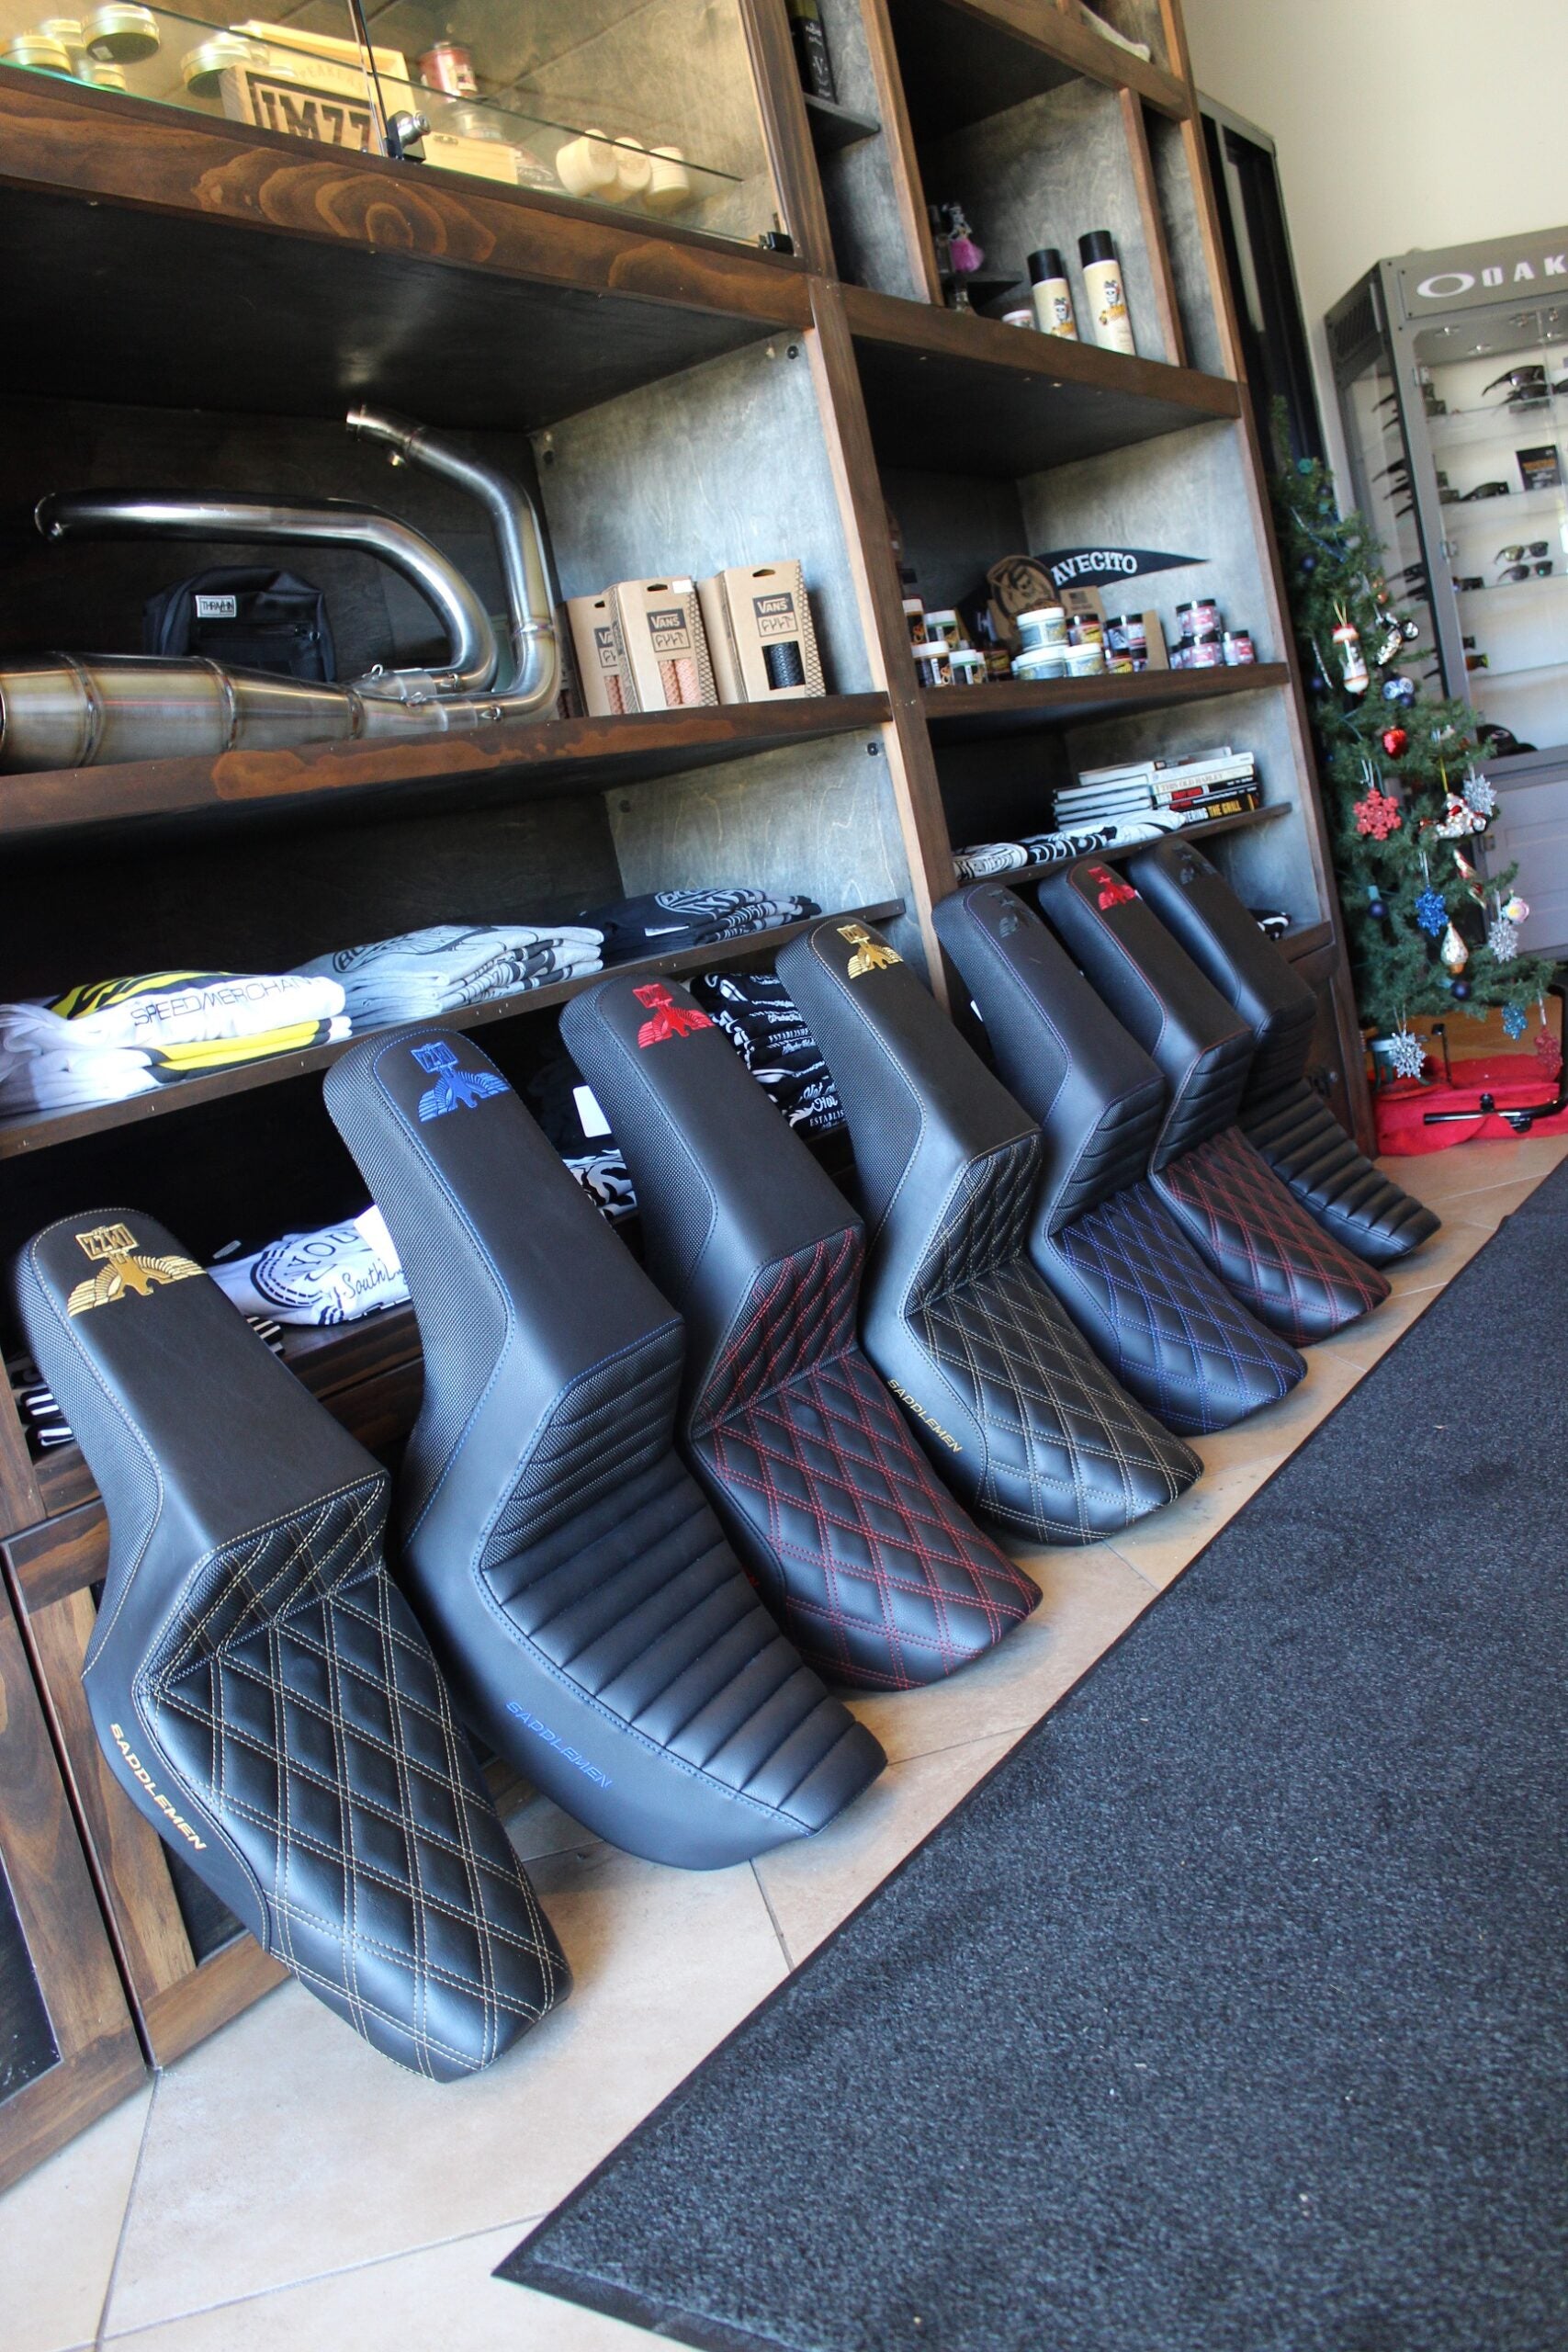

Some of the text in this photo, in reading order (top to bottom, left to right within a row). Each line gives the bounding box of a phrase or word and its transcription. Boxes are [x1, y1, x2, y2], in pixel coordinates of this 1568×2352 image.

[1482, 254, 1568, 287] OAK
[1051, 551, 1137, 585] AVECITO
[650, 613, 681, 628] VANS
[757, 597, 789, 614] VANS
[887, 1379, 963, 1453] SADDLEMEN
[504, 1702, 613, 1789] SADDLEMEN
[110, 1723, 208, 1850] SADDLEMEN
